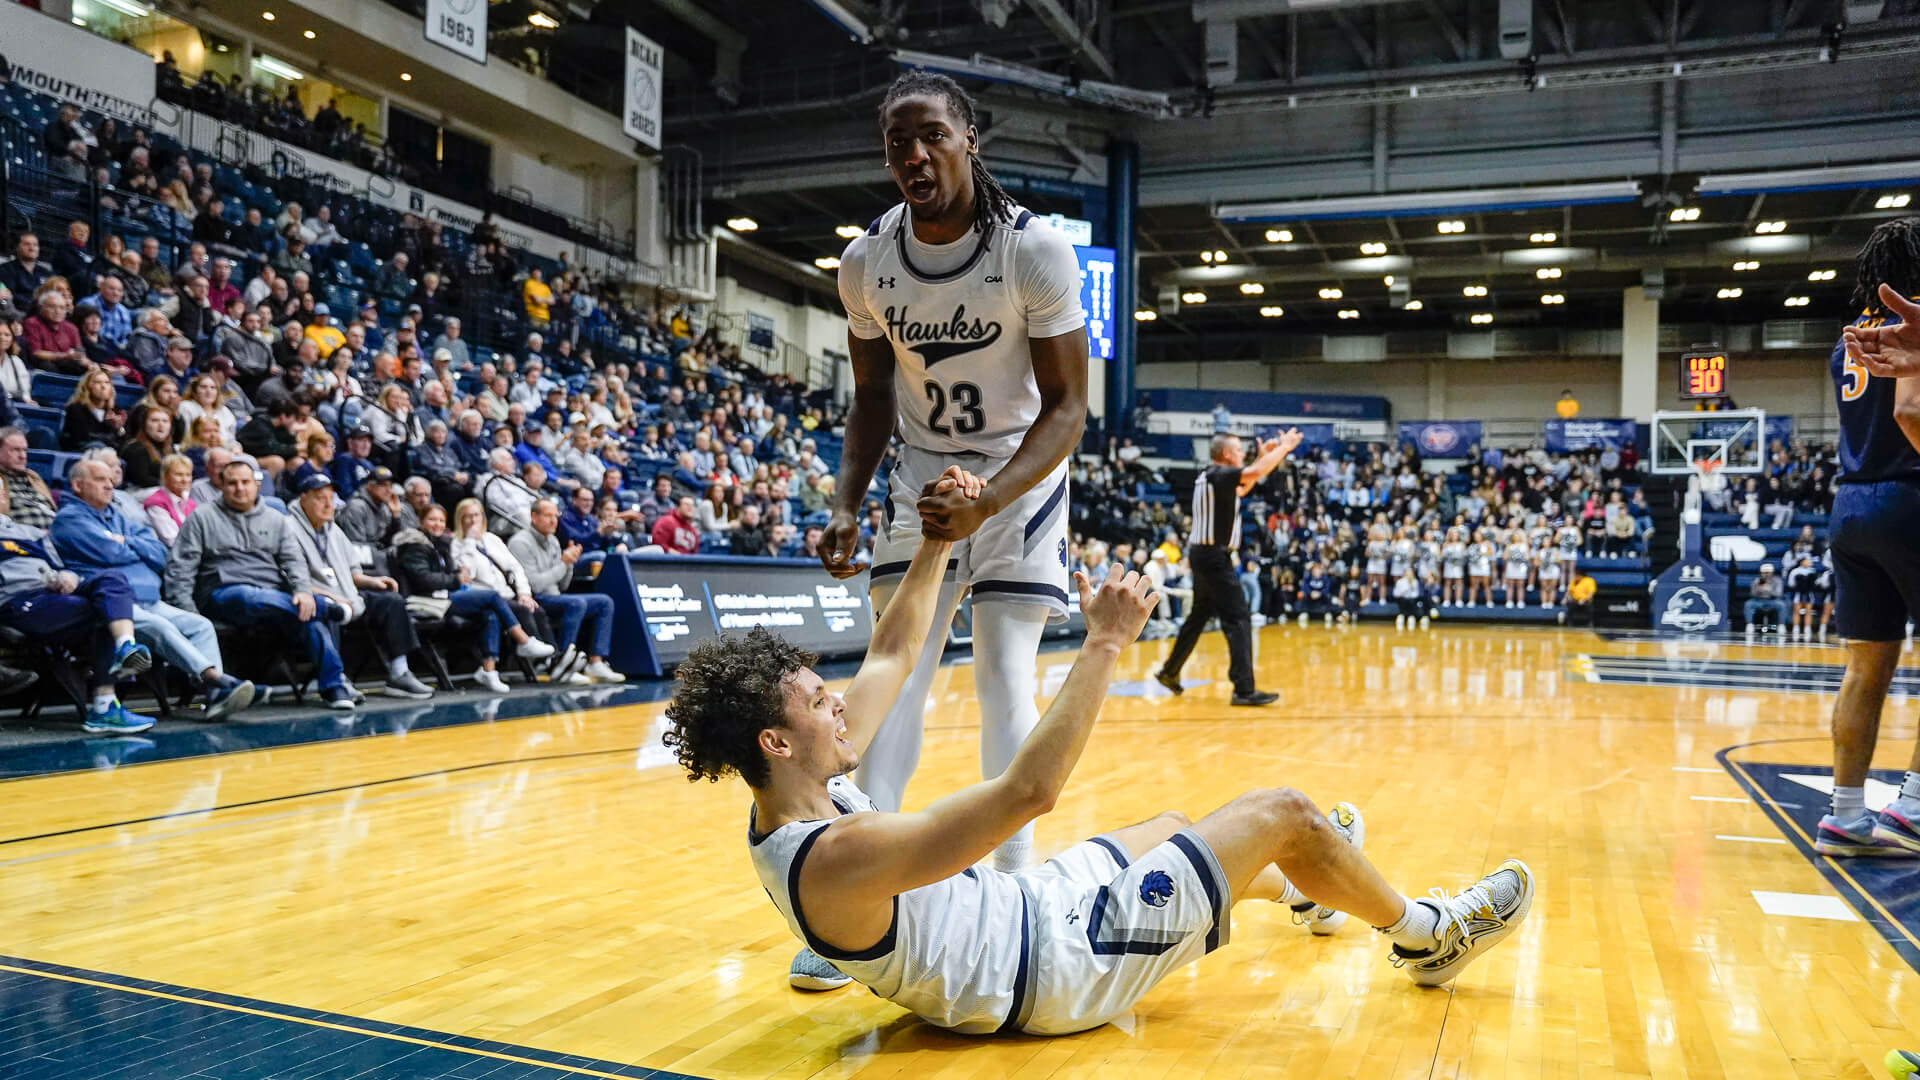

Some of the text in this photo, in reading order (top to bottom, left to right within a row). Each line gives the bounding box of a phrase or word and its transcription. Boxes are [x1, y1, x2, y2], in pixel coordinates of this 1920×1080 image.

[440, 13, 474, 47] 1983
[630, 38, 659, 71] NCAA
[630, 111, 656, 138] 2023
[985, 275, 1003, 283] CAA
[884, 304, 1002, 345] Hawks
[1689, 370, 1721, 394] 30
[1841, 344, 1869, 402] 5
[924, 380, 986, 438] 23
